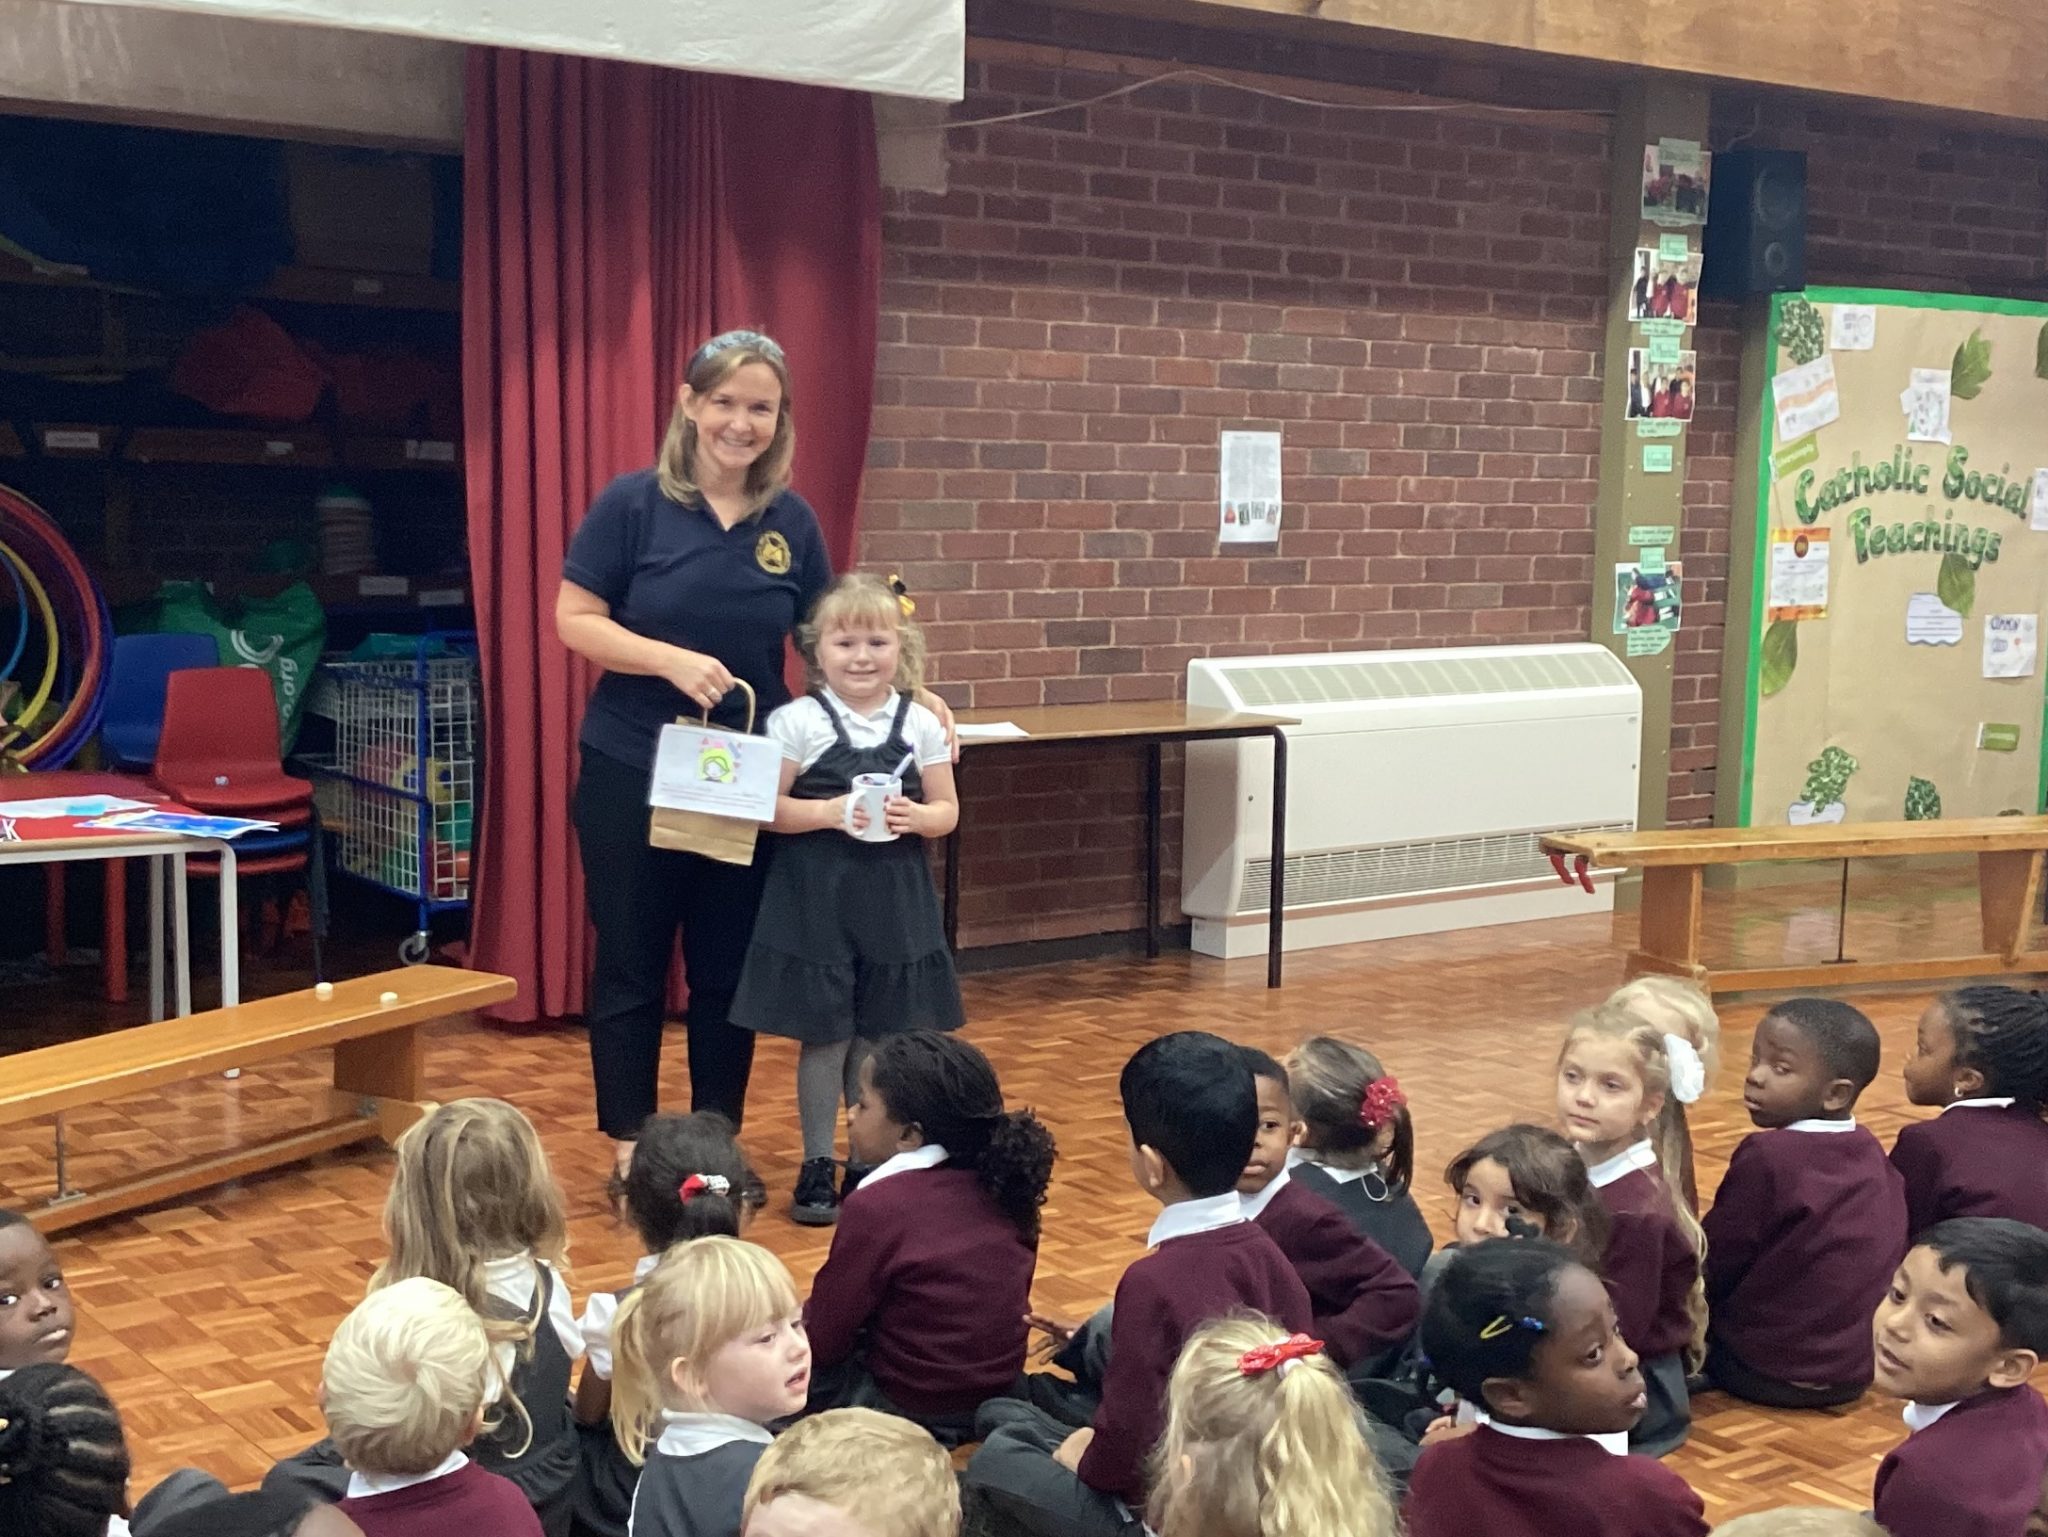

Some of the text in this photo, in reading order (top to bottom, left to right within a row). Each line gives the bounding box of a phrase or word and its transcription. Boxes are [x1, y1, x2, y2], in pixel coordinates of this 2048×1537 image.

[1794, 444, 2034, 524] Catholic Social
[1847, 504, 2003, 571] Teachings
